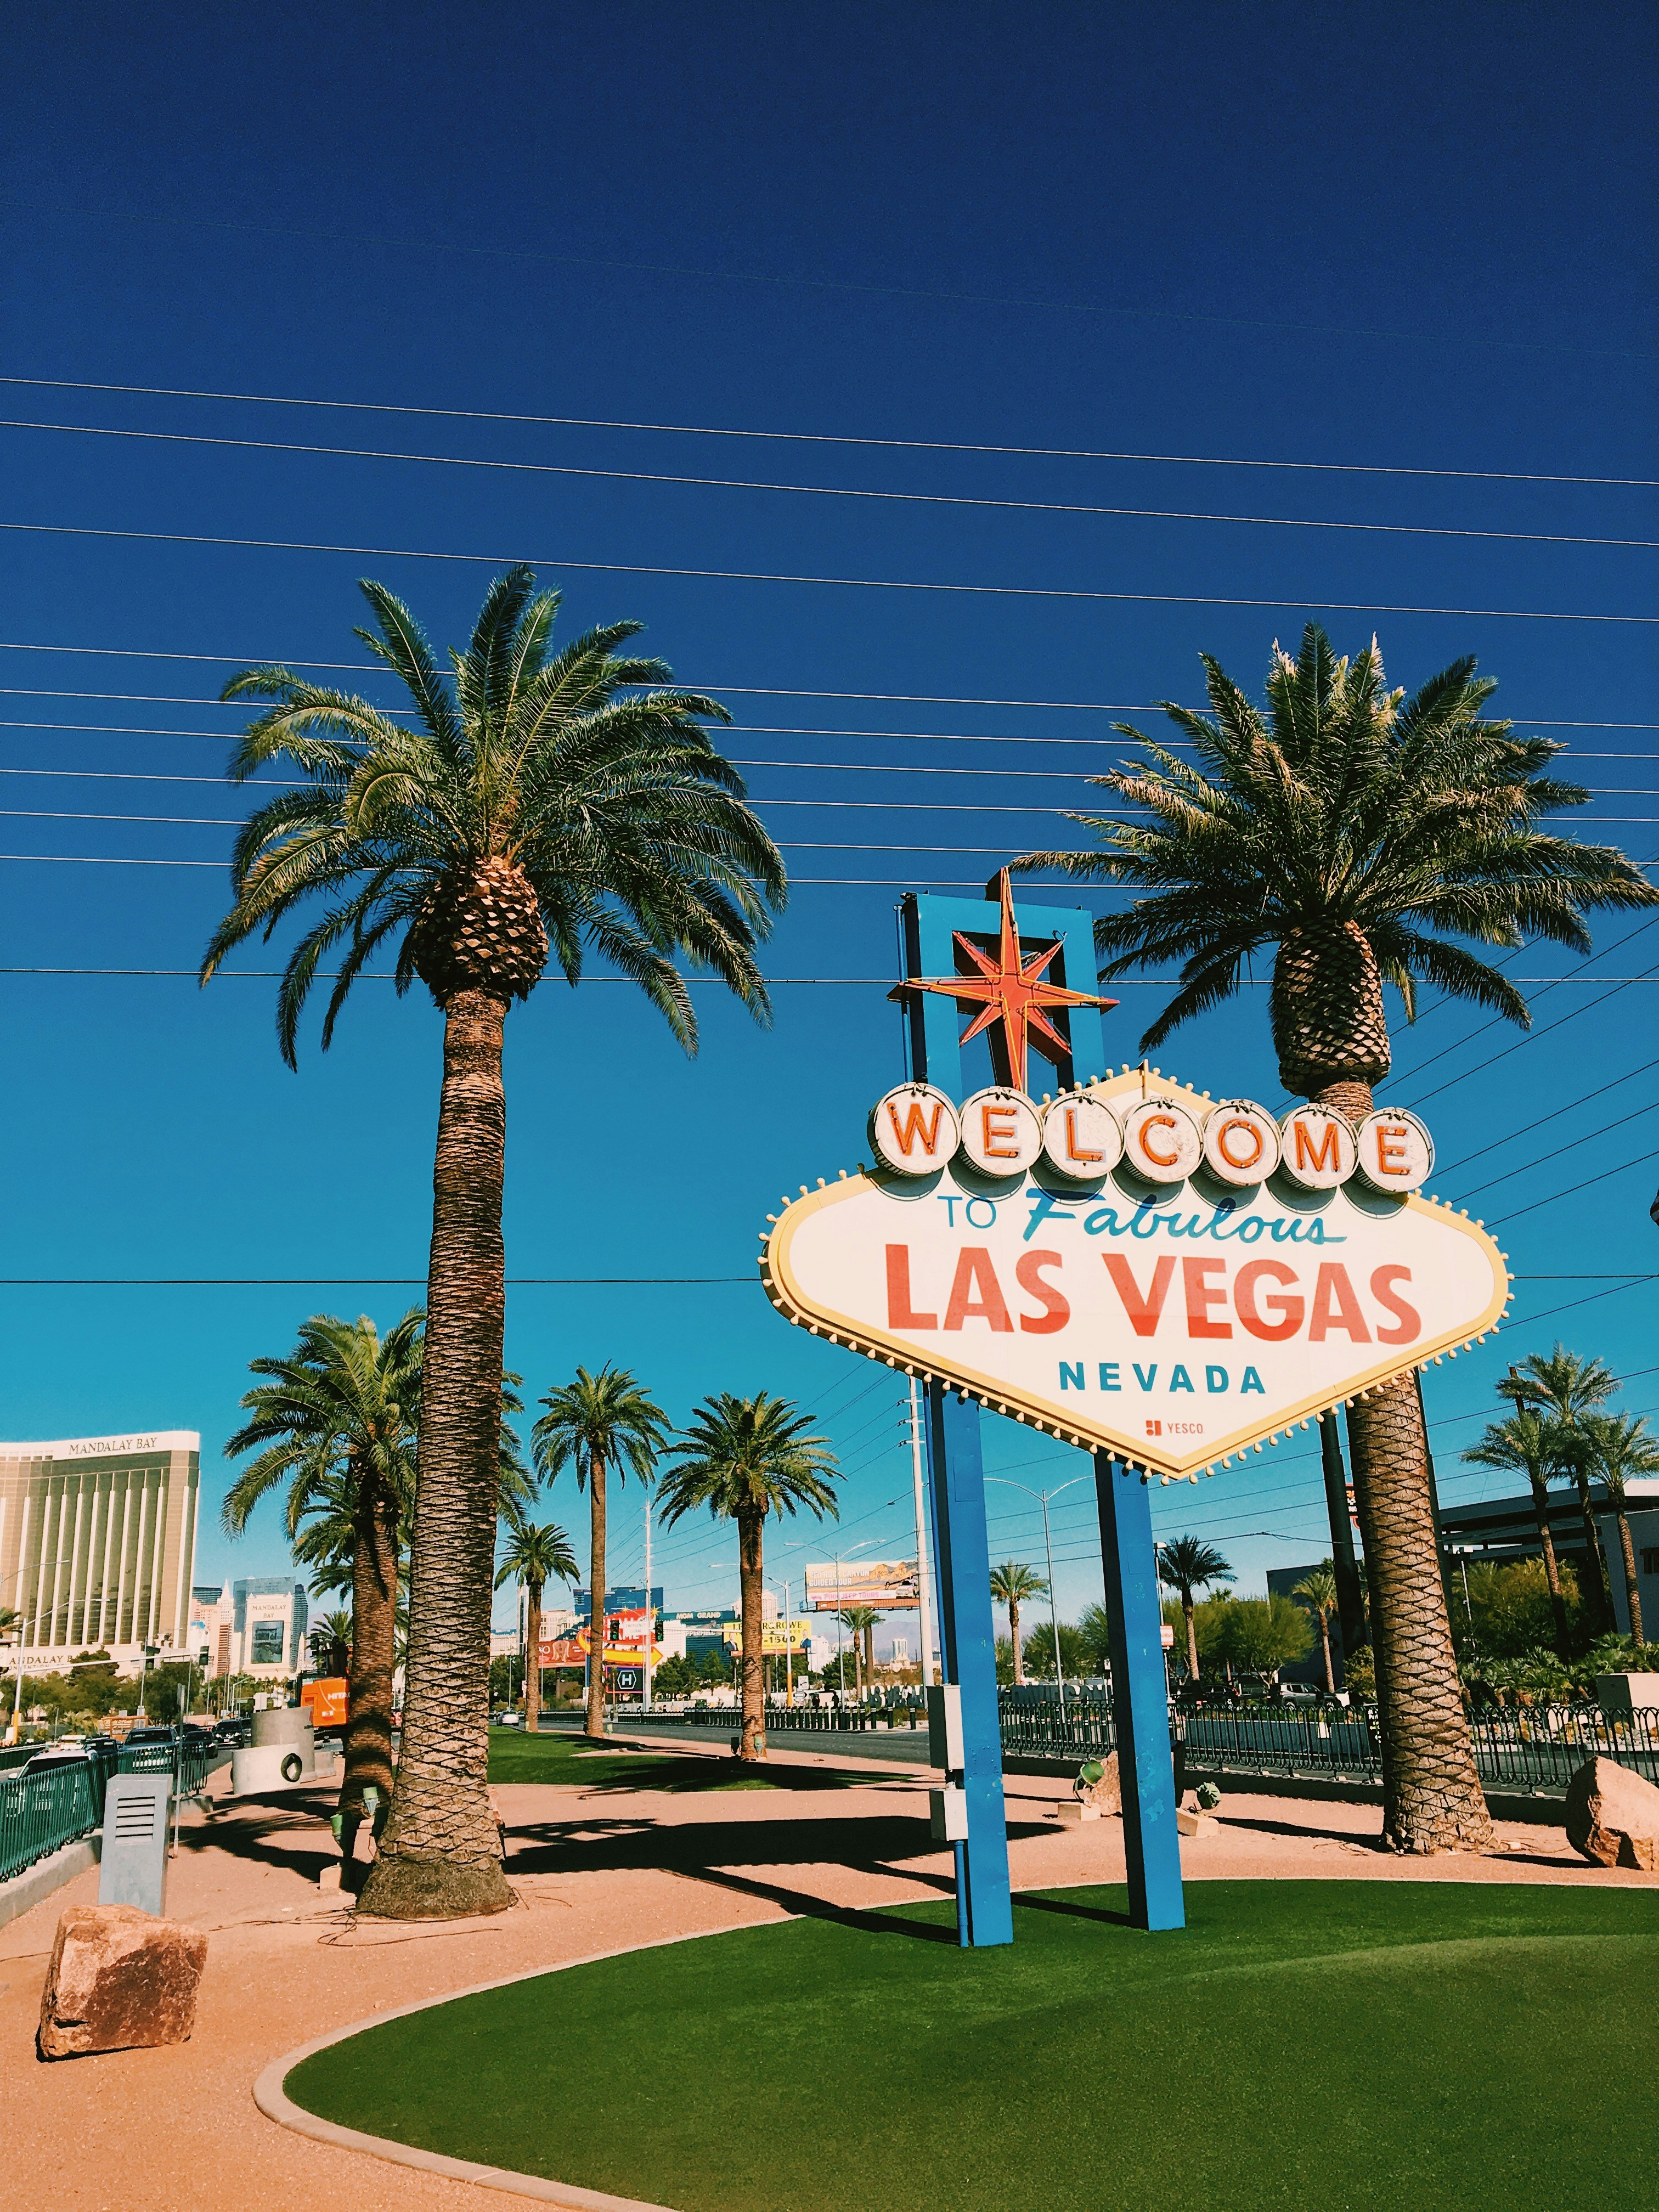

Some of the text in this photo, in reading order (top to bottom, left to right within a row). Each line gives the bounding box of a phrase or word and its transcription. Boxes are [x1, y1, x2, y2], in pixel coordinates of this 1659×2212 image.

[885, 1102, 1411, 1176] WELCOME
[937, 1187, 1347, 1245] TO Fabulous
[884, 1243, 1423, 1345] LAS VEGAS
[1058, 1362, 1266, 1394] NEVADA
[1167, 1423, 1204, 1434] YESCO
[69, 1437, 157, 1454] MANDALAY BAY
[843, 1569, 870, 1577] CANYON
[809, 1578, 833, 1587] GUIDED
[9, 1655, 64, 1665] ANDALAY
